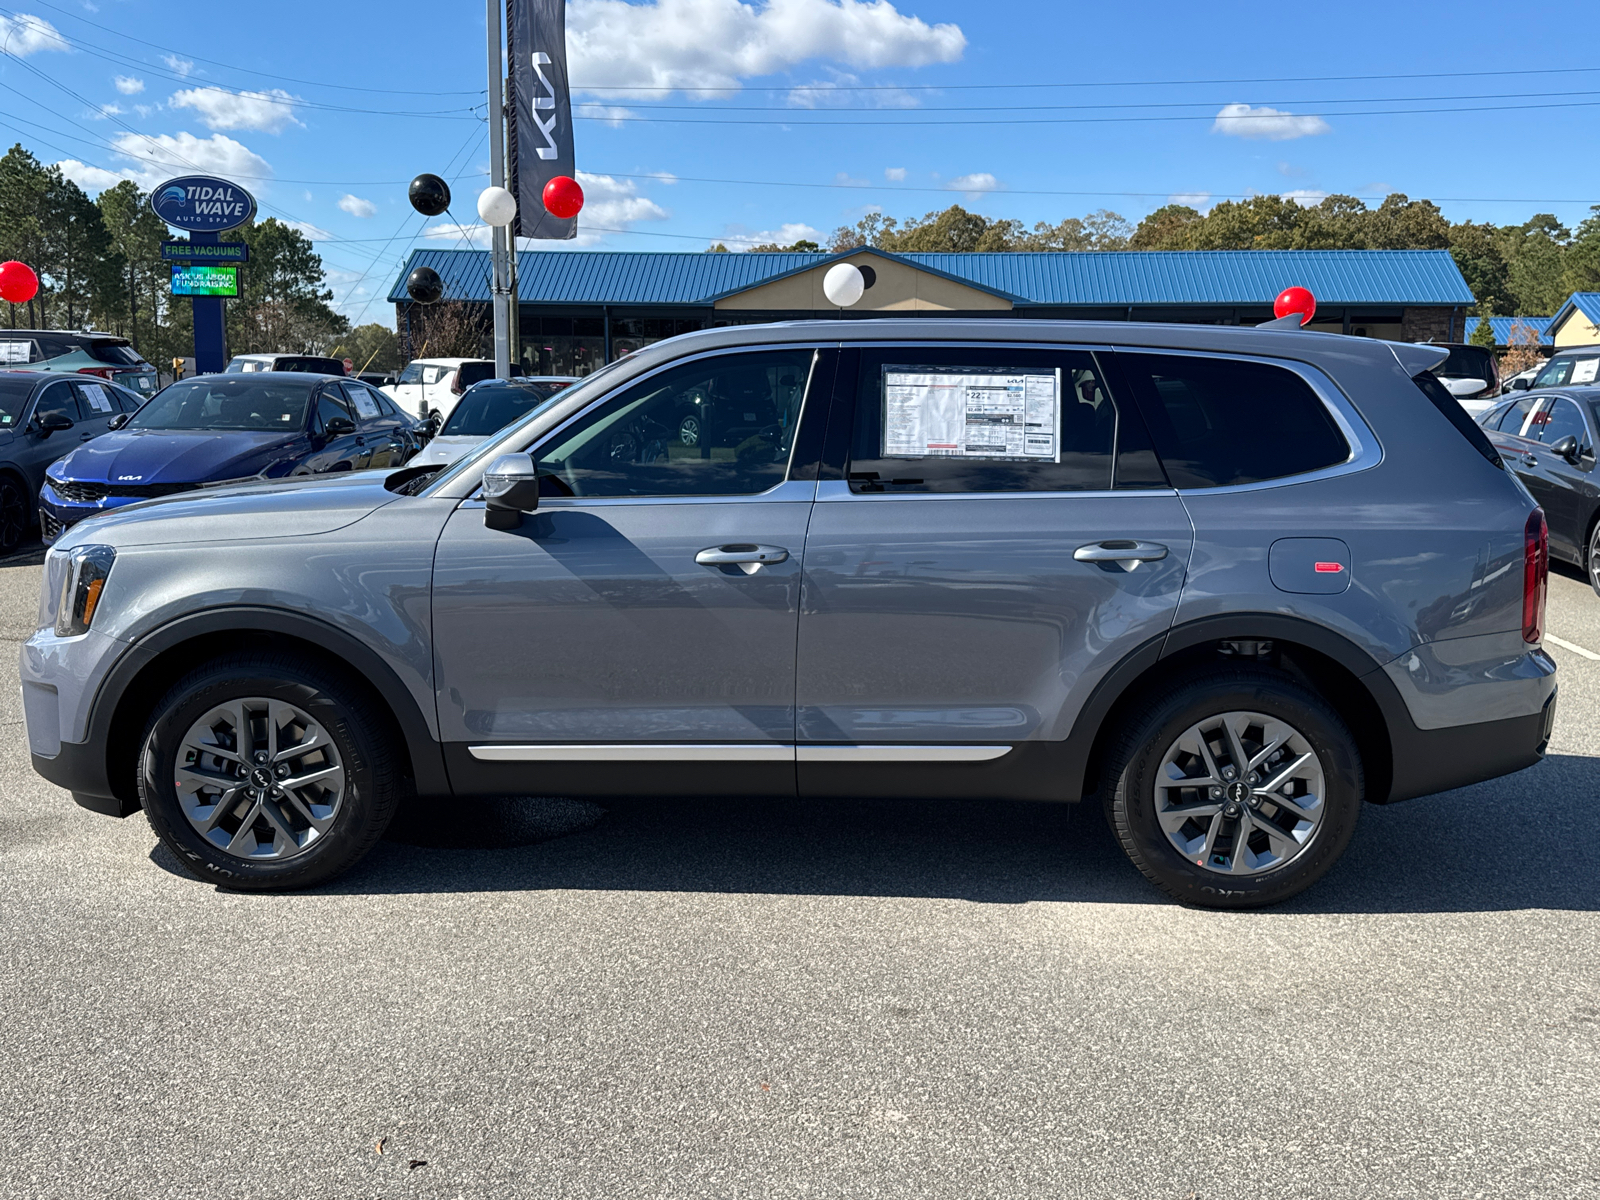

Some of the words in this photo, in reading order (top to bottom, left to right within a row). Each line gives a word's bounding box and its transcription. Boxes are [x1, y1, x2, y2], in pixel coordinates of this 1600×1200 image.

[532, 52, 558, 160] KIA
[187, 186, 234, 201] TIDAL
[195, 201, 244, 216] WAVE
[165, 245, 192, 255] FREE
[193, 246, 242, 256] VACUUMS
[176, 280, 234, 288] FUNDRAISING
